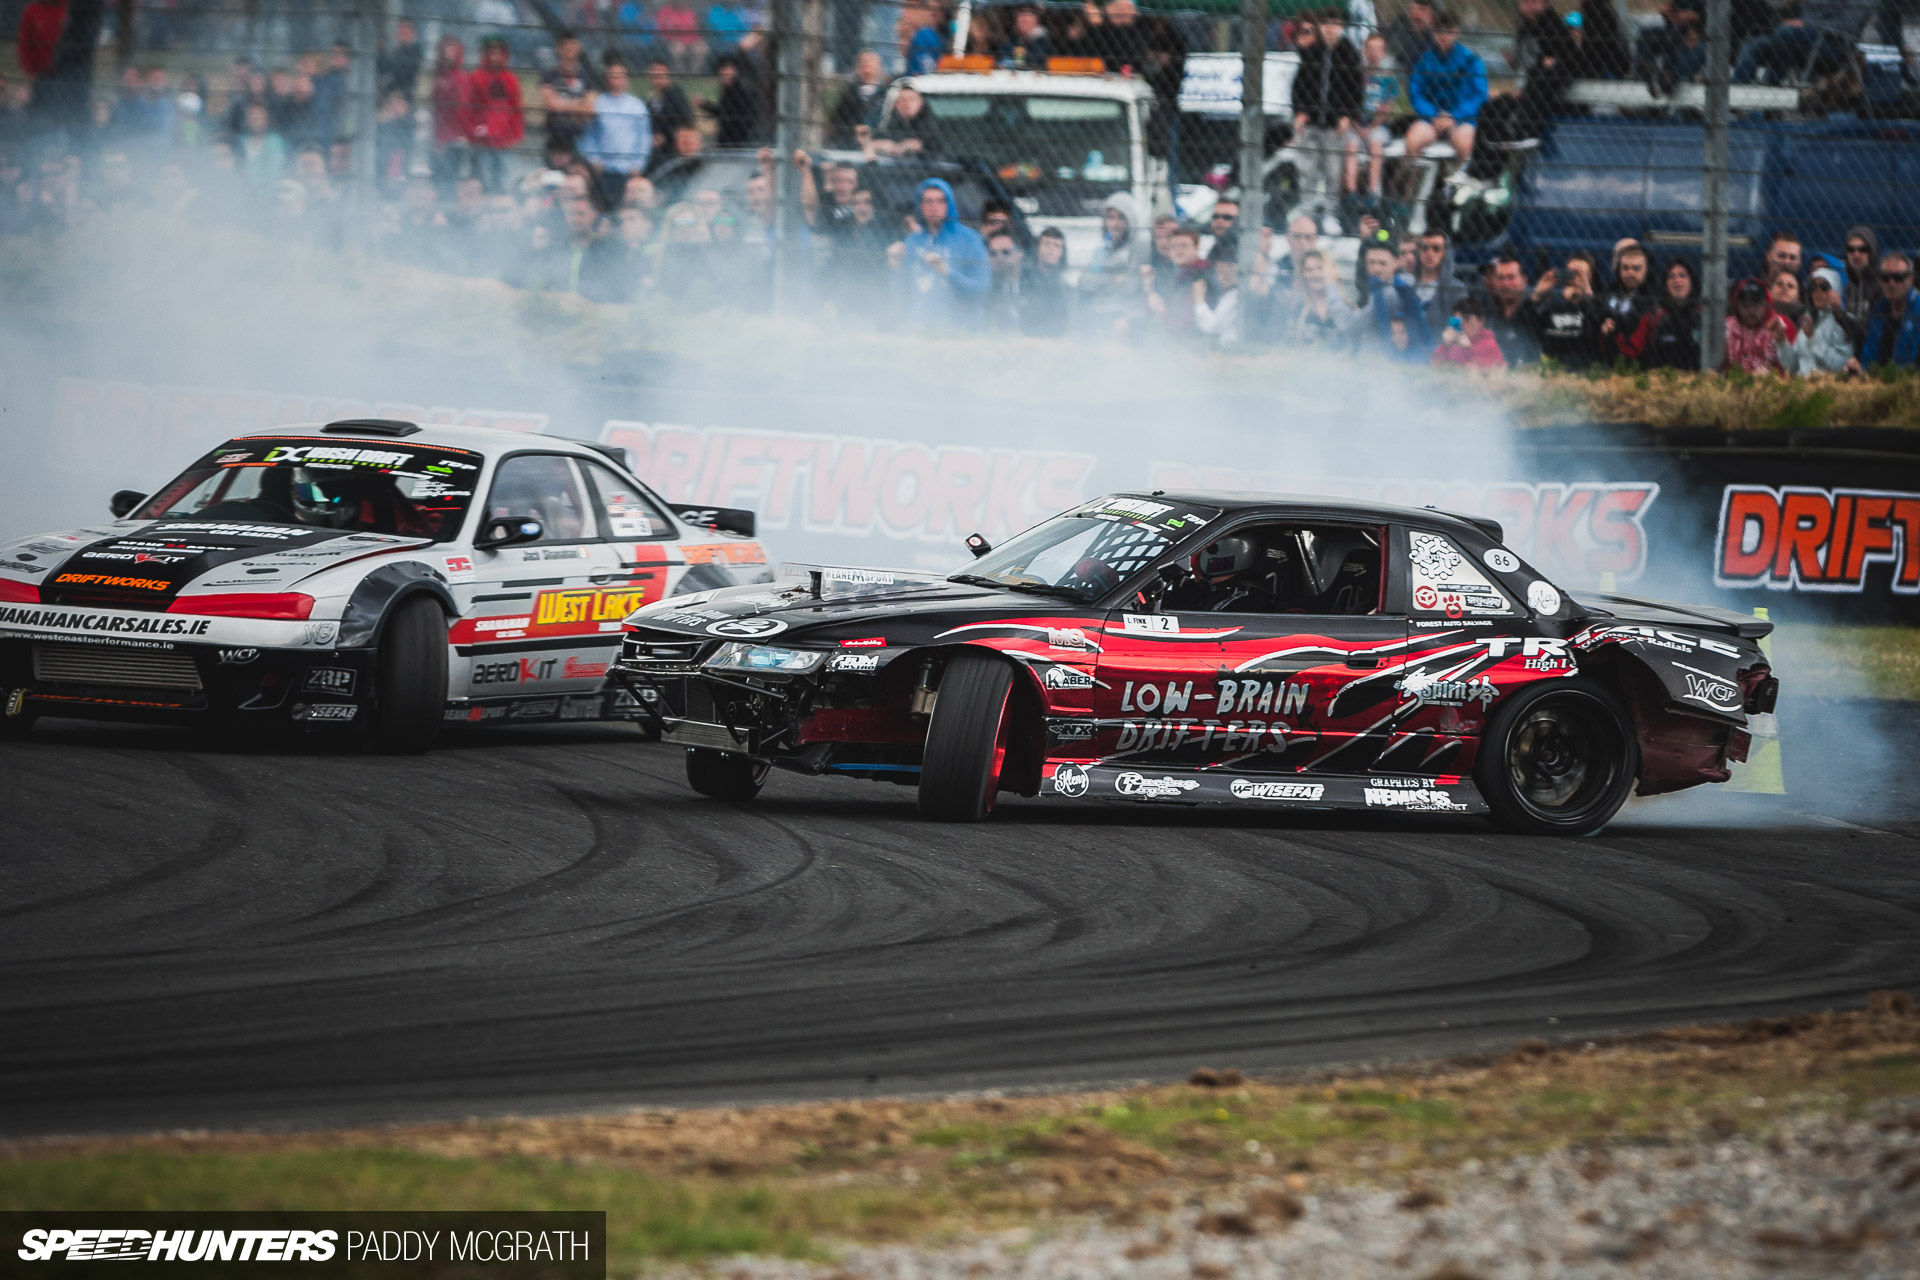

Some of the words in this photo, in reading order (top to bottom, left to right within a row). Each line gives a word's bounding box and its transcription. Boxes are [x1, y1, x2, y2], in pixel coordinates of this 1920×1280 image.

[1493, 554, 1510, 567] 86
[55, 573, 172, 591] DRIFTWORKS
[1160, 617, 1170, 631] 2
[216, 648, 261, 664] WCP
[1523, 658, 1558, 672] High
[1647, 637, 1692, 654] Radials
[1370, 777, 1420, 788] GRAPHICS
[1421, 778, 1436, 788] BY
